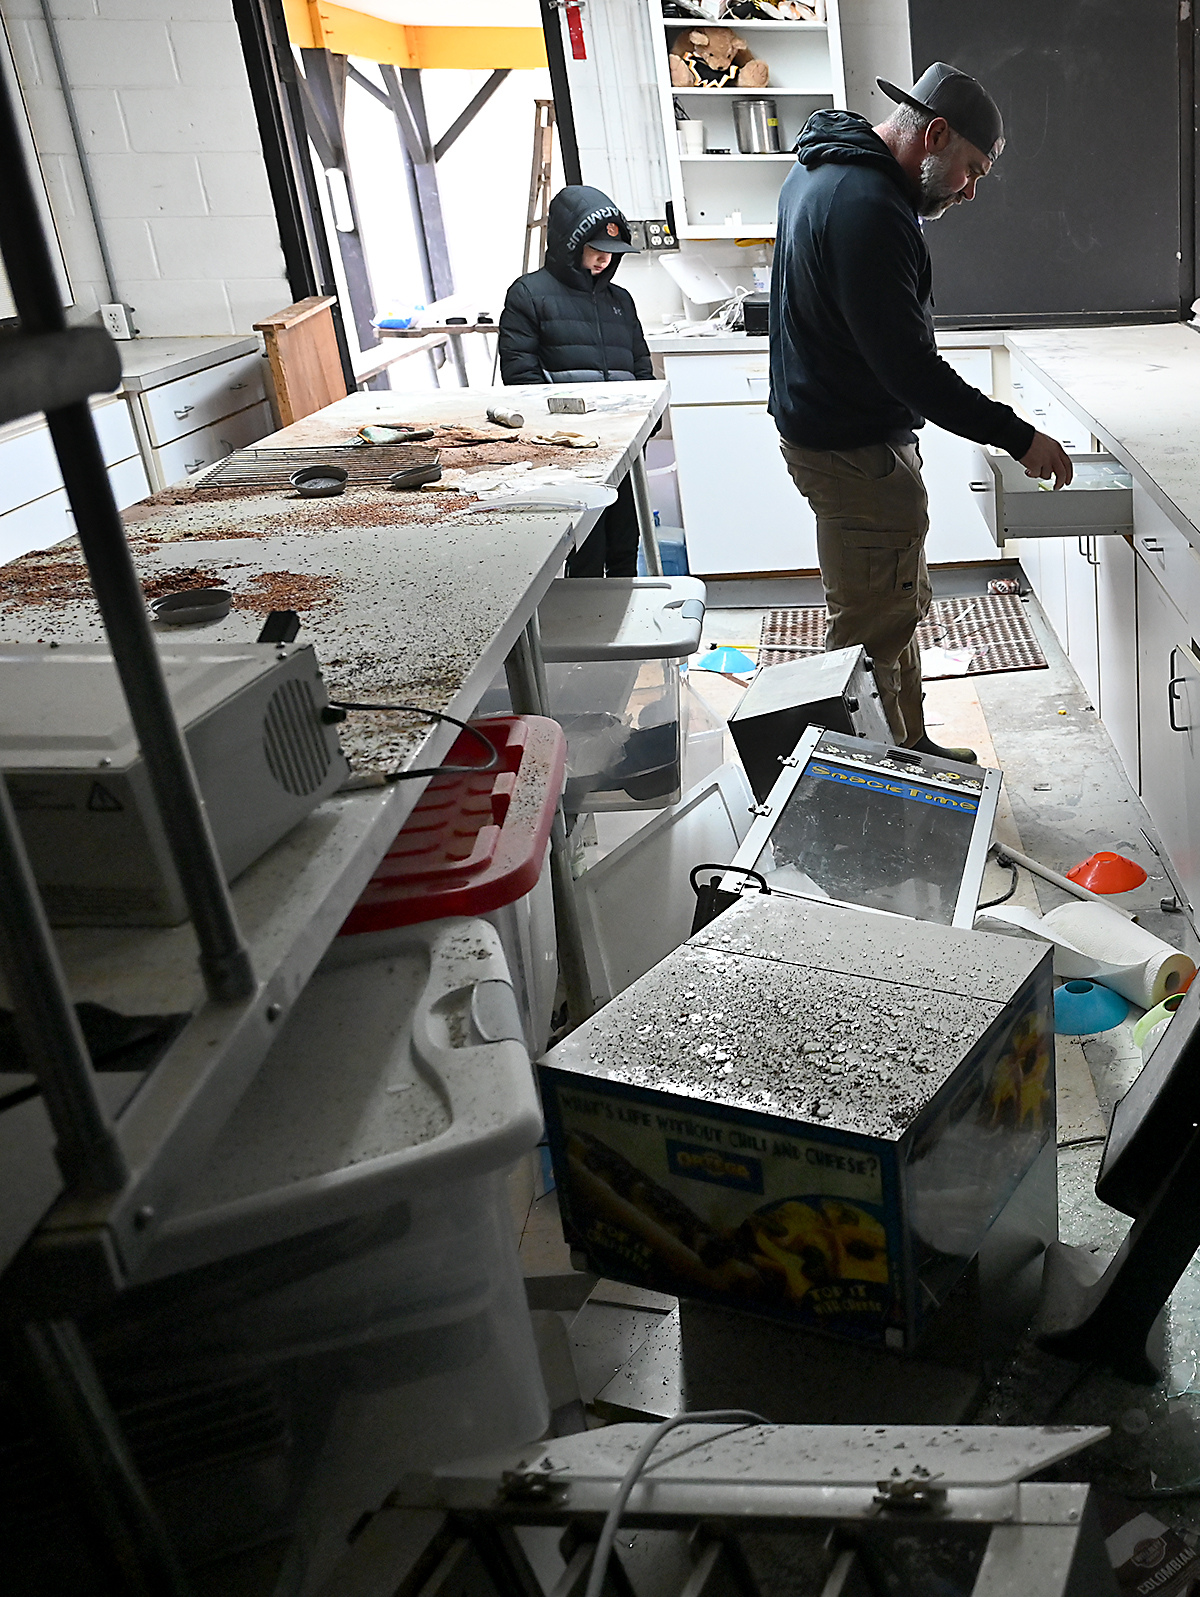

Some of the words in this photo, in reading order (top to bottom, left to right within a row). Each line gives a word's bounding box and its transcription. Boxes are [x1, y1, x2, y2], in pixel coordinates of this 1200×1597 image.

[566, 206, 620, 251] ARMOUR
[618, 1107, 651, 1127] LIFE
[656, 1115, 723, 1144] WITHOUT
[1137, 1547, 1197, 1595] COLOMBIAN
